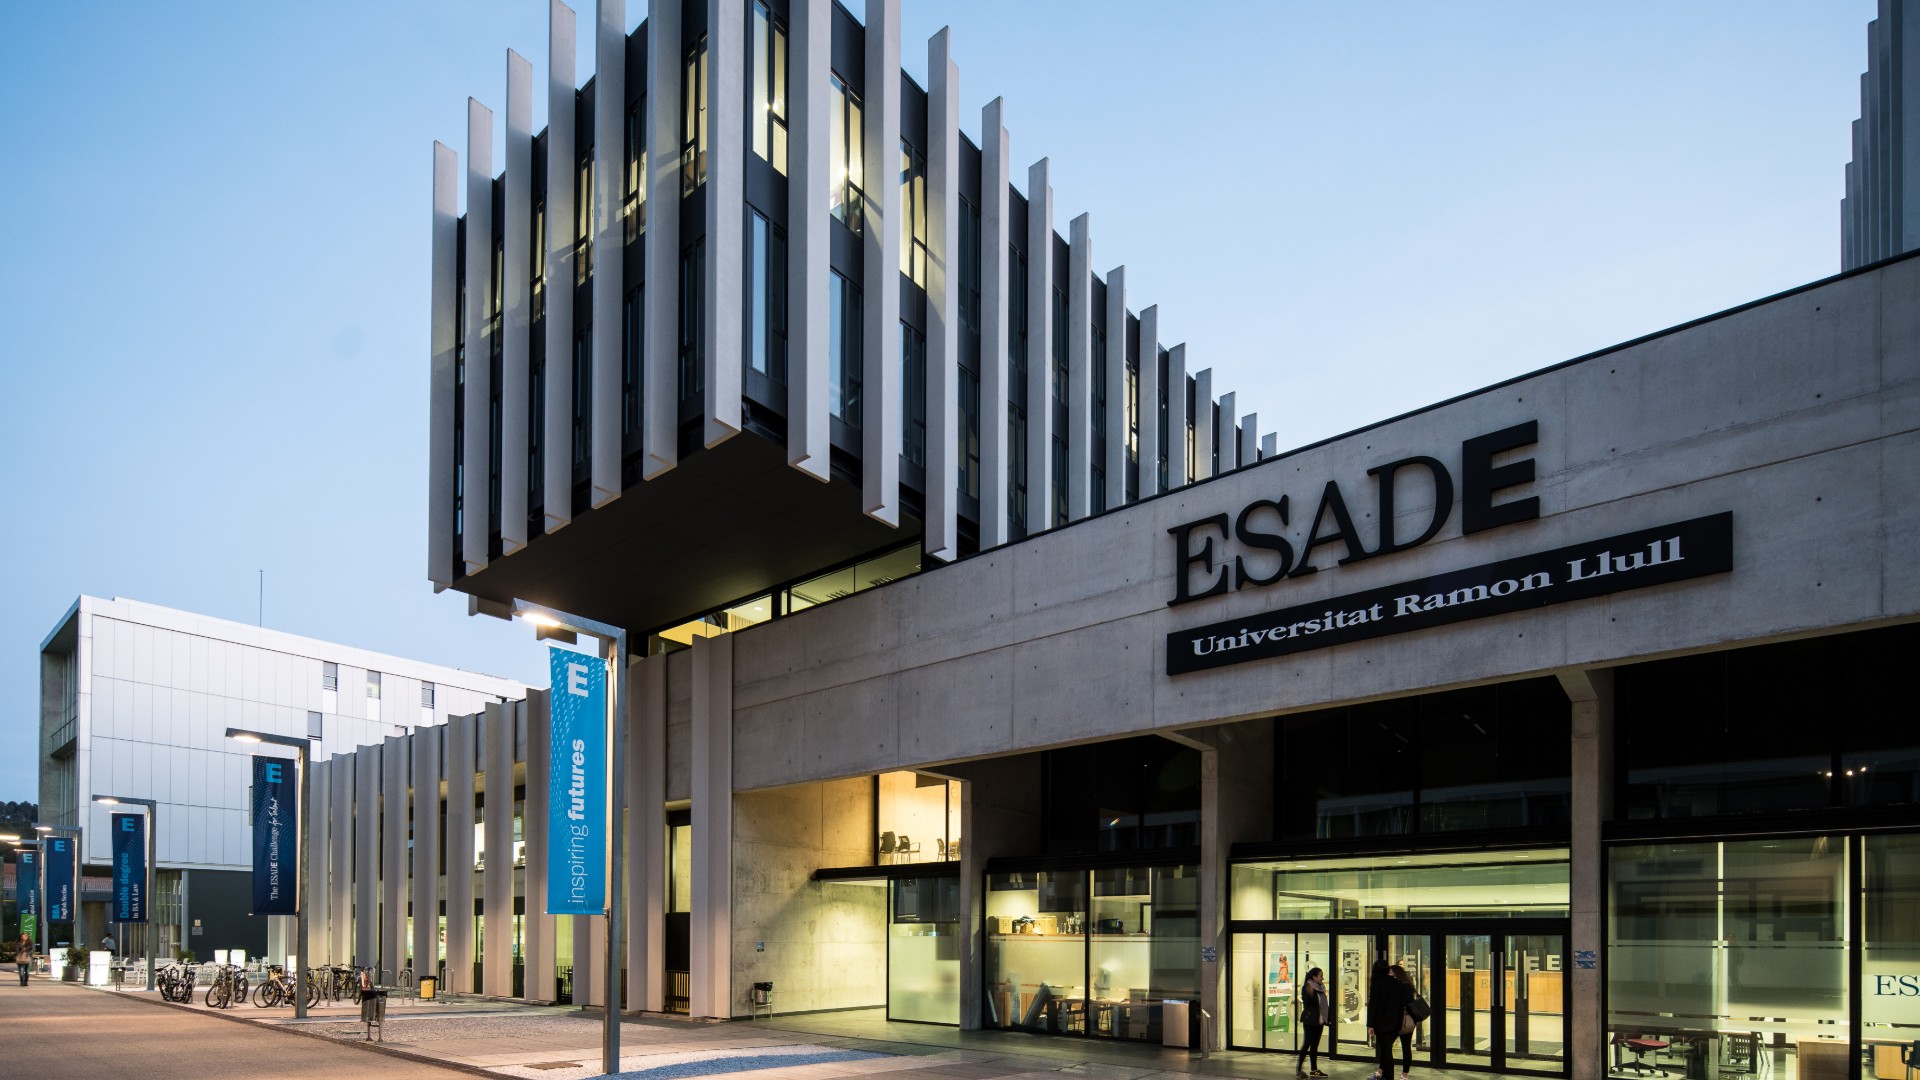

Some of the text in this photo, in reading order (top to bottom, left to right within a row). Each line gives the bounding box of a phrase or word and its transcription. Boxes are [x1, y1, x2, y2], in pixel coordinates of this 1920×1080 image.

[1167, 419, 1540, 606] ESADE
[1192, 535, 1685, 657] Universitat Ramon Llull
[568, 662, 588, 697] E
[265, 763, 282, 784] E
[268, 817, 282, 827] for
[567, 738, 589, 903] inspiring futures
[270, 827, 279, 861] Challenge
[119, 852, 130, 919] Double degree
[270, 862, 278, 885] ESADE
[270, 887, 278, 900] The
[1873, 975, 1920, 996] ES
